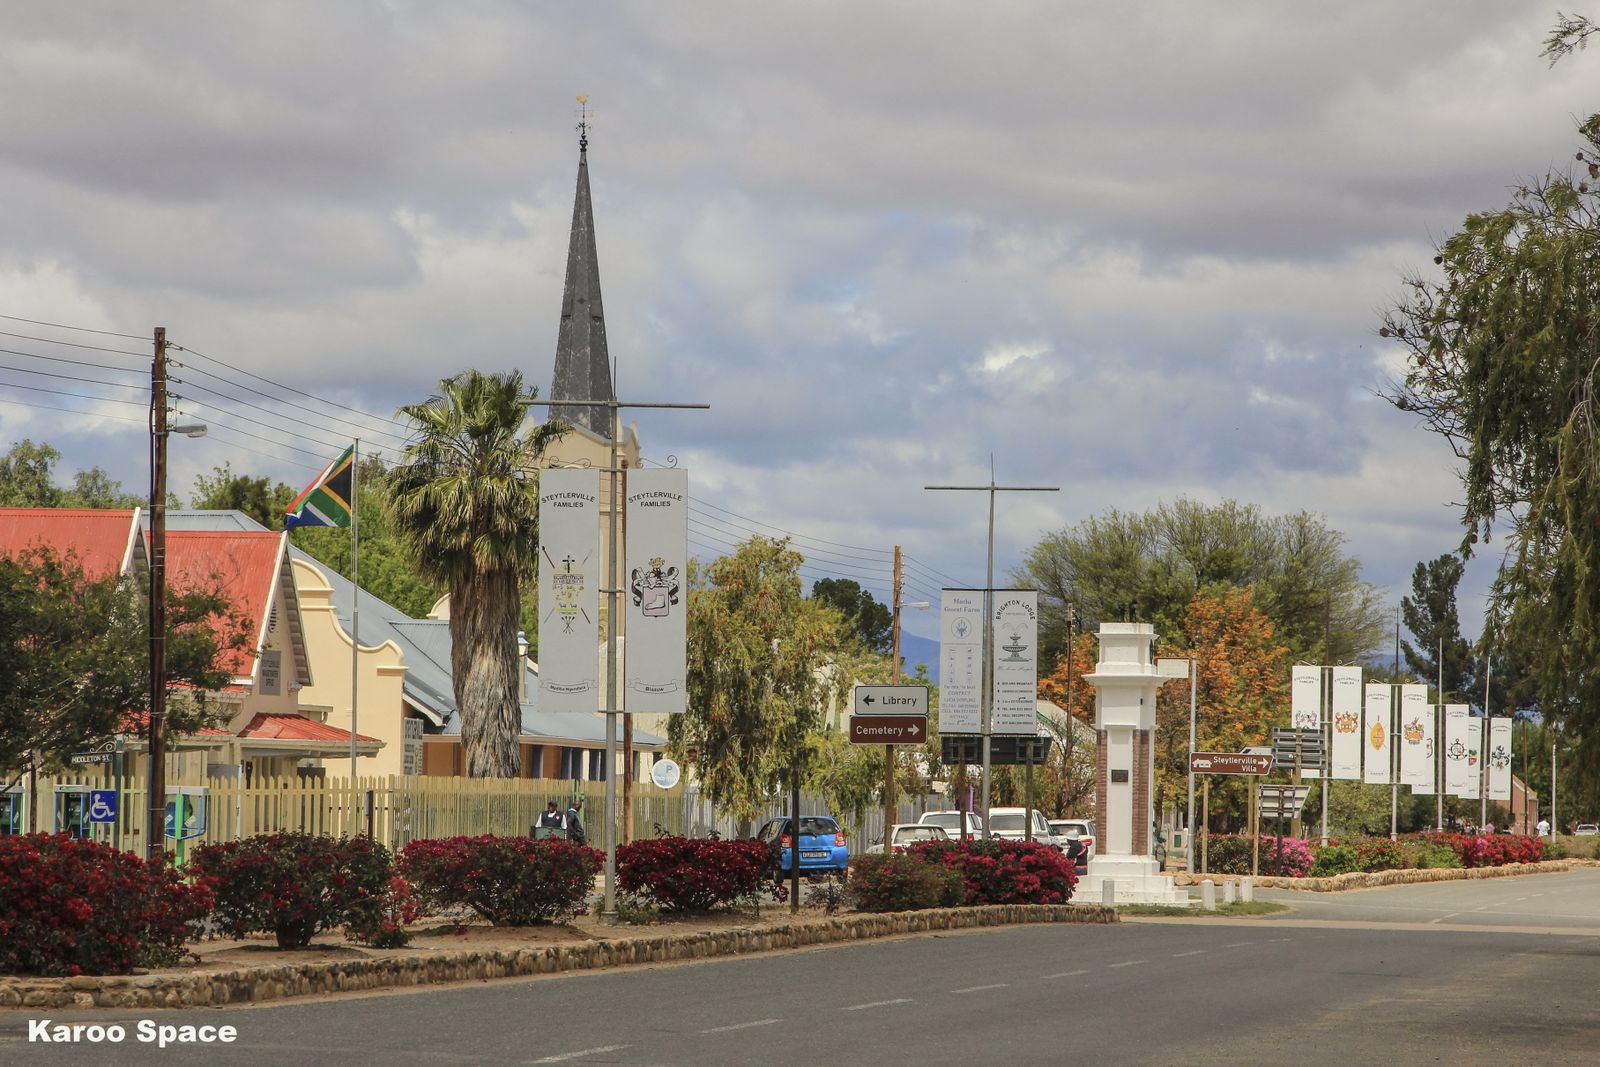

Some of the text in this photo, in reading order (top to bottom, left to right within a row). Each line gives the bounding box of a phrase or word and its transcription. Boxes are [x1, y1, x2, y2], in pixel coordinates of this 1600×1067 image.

[541, 492, 596, 504] STEYTLERVILLE
[628, 491, 683, 503] STEYTLERVILLE
[996, 599, 1036, 620] BRIGHTON LODGE
[882, 695, 917, 707] Library
[856, 725, 904, 737] Cemetery
[1213, 756, 1257, 765] Steytlerville
[1241, 765, 1257, 773] Villa
